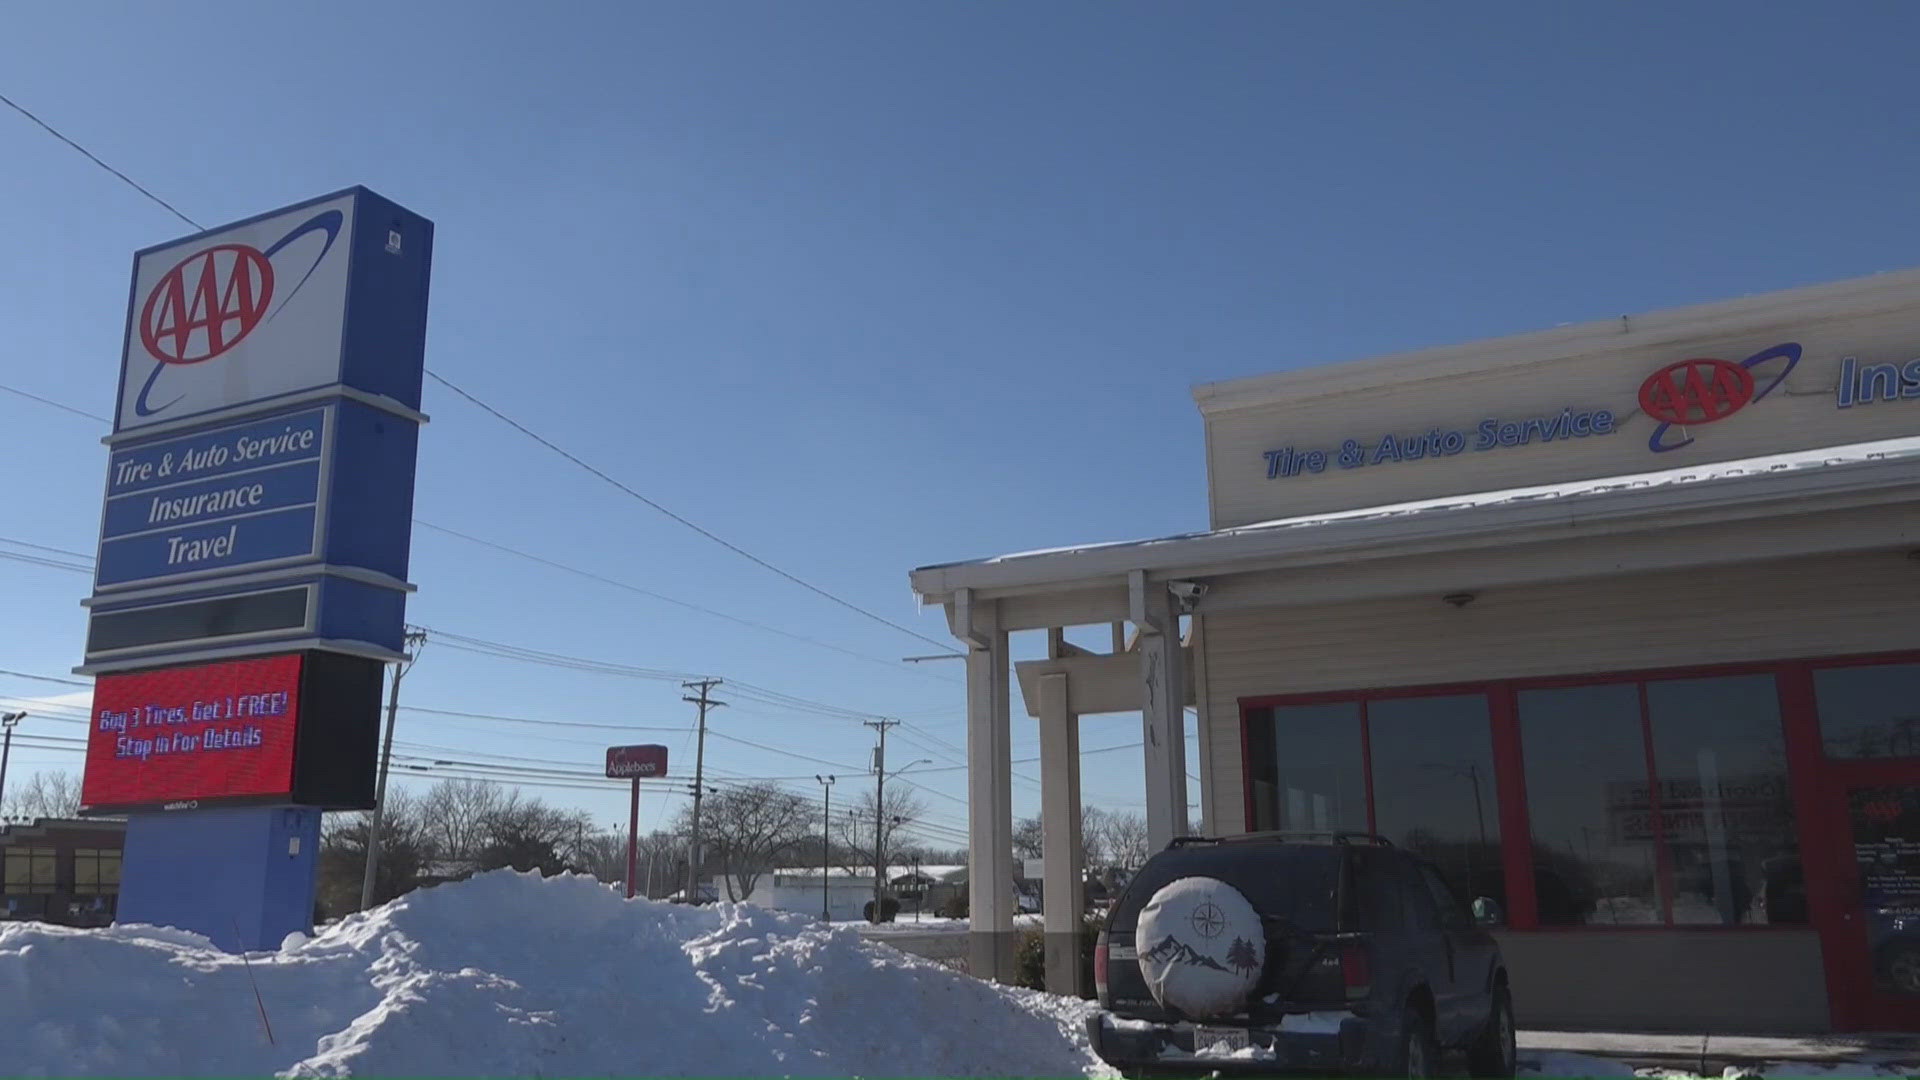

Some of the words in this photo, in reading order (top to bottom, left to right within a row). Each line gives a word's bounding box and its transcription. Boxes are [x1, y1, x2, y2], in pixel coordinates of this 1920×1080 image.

[144, 246, 269, 362] AAA
[1643, 360, 1750, 423] AAA
[115, 459, 152, 486] Tire
[158, 453, 173, 477] &
[177, 445, 228, 473] Auto
[233, 427, 313, 462] Service
[1263, 446, 1326, 479] Tire
[1338, 439, 1364, 468] &
[1373, 428, 1465, 464] Auto
[1474, 407, 1615, 450] Service
[149, 484, 263, 523] Insurance
[168, 526, 236, 564] Travel
[100, 711, 127, 733] Buy
[132, 708, 140, 728] 3
[193, 701, 220, 721] Get
[225, 698, 233, 718] 1
[237, 692, 288, 716] FREE!
[116, 736, 152, 761] Stop
[173, 732, 199, 752] For
[203, 727, 262, 749] Details
